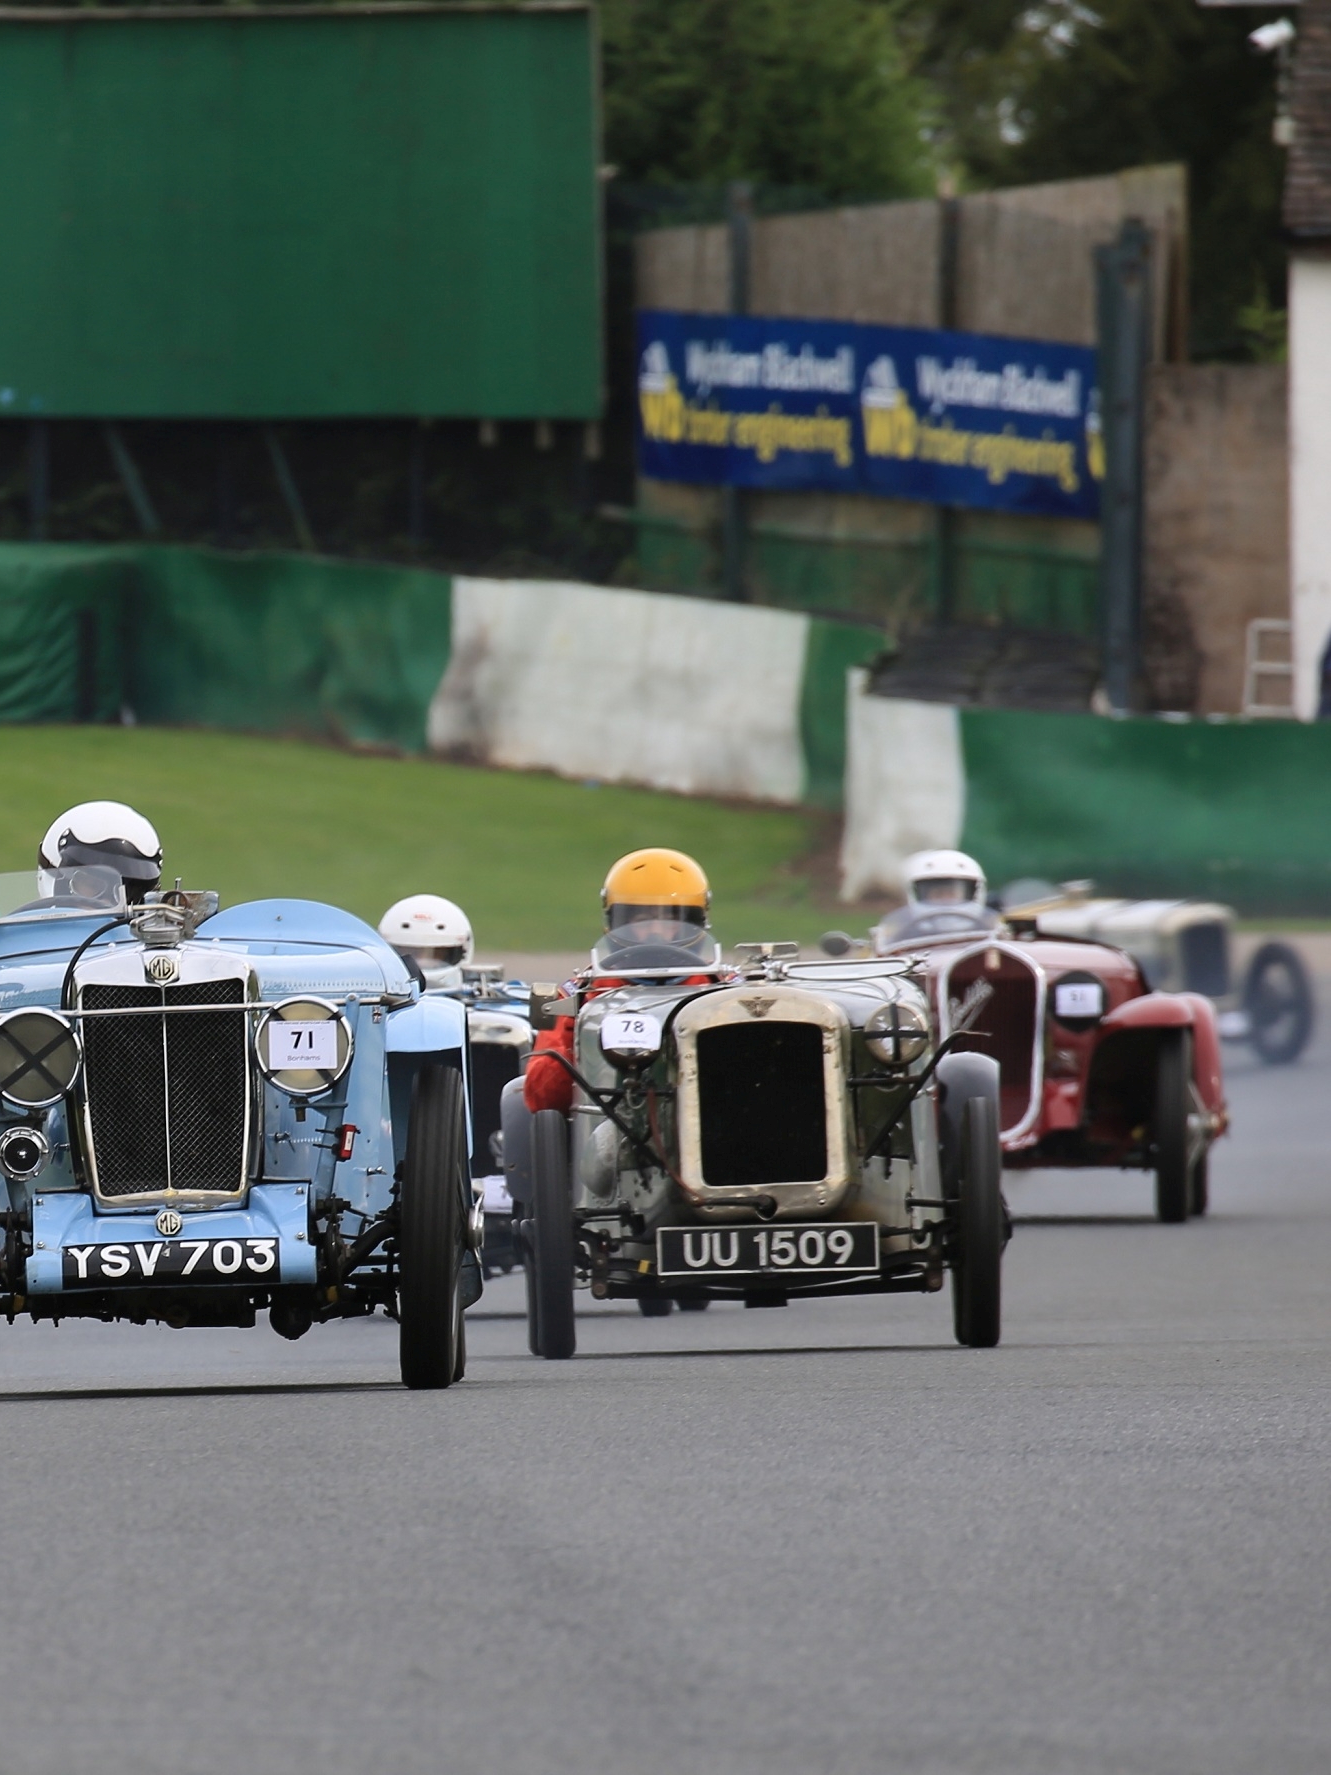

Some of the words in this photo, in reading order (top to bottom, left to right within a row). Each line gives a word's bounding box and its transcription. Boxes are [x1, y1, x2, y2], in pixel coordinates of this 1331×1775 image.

[152, 958, 171, 977] MG
[621, 1020, 644, 1033] 78
[290, 1030, 314, 1049] 71
[158, 1211, 180, 1234] MG
[683, 1232, 738, 1267] UU
[753, 1229, 854, 1267] 1509
[68, 1242, 164, 1279] YSV
[179, 1239, 276, 1275] 703
